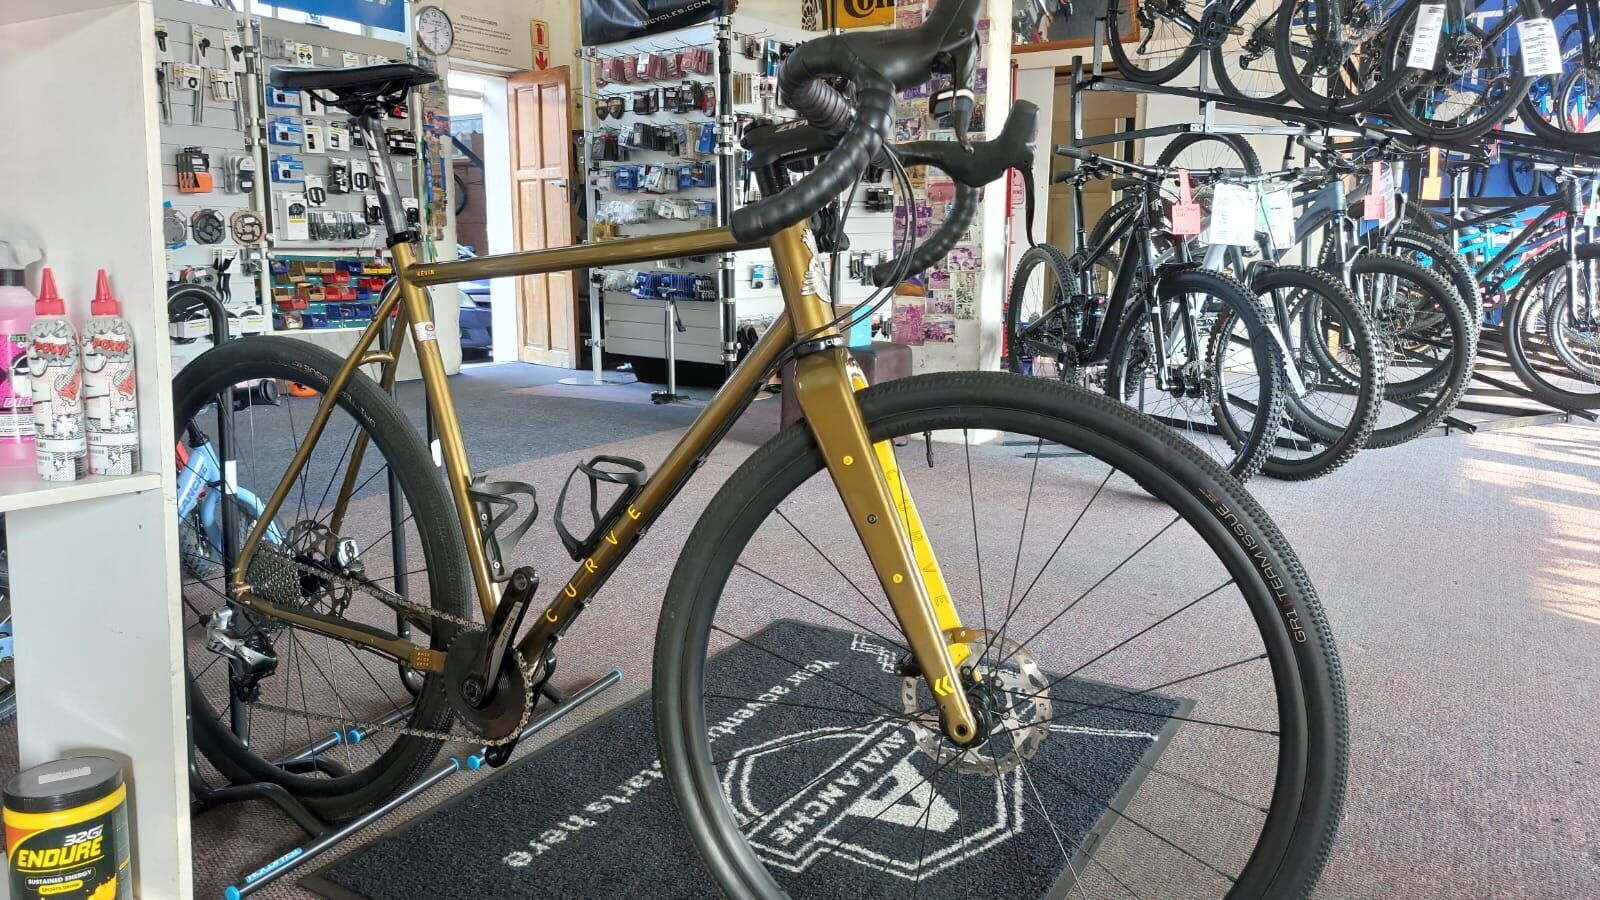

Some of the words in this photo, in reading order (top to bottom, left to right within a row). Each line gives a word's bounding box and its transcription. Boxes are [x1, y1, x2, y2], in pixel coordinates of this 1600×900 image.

[361, 127, 392, 195] ZIPP
[1215, 503, 1259, 551] ISSUE
[545, 503, 642, 623] CURVE
[1255, 551, 1288, 602] TEAM
[785, 659, 840, 687] Your
[708, 684, 790, 743] adventu
[769, 729, 907, 846] AVALANCHE
[17, 836, 104, 869] ENDURE
[501, 814, 598, 868] here
[27, 876, 64, 886] SUSTAINED
[65, 869, 92, 882] ENERGY
